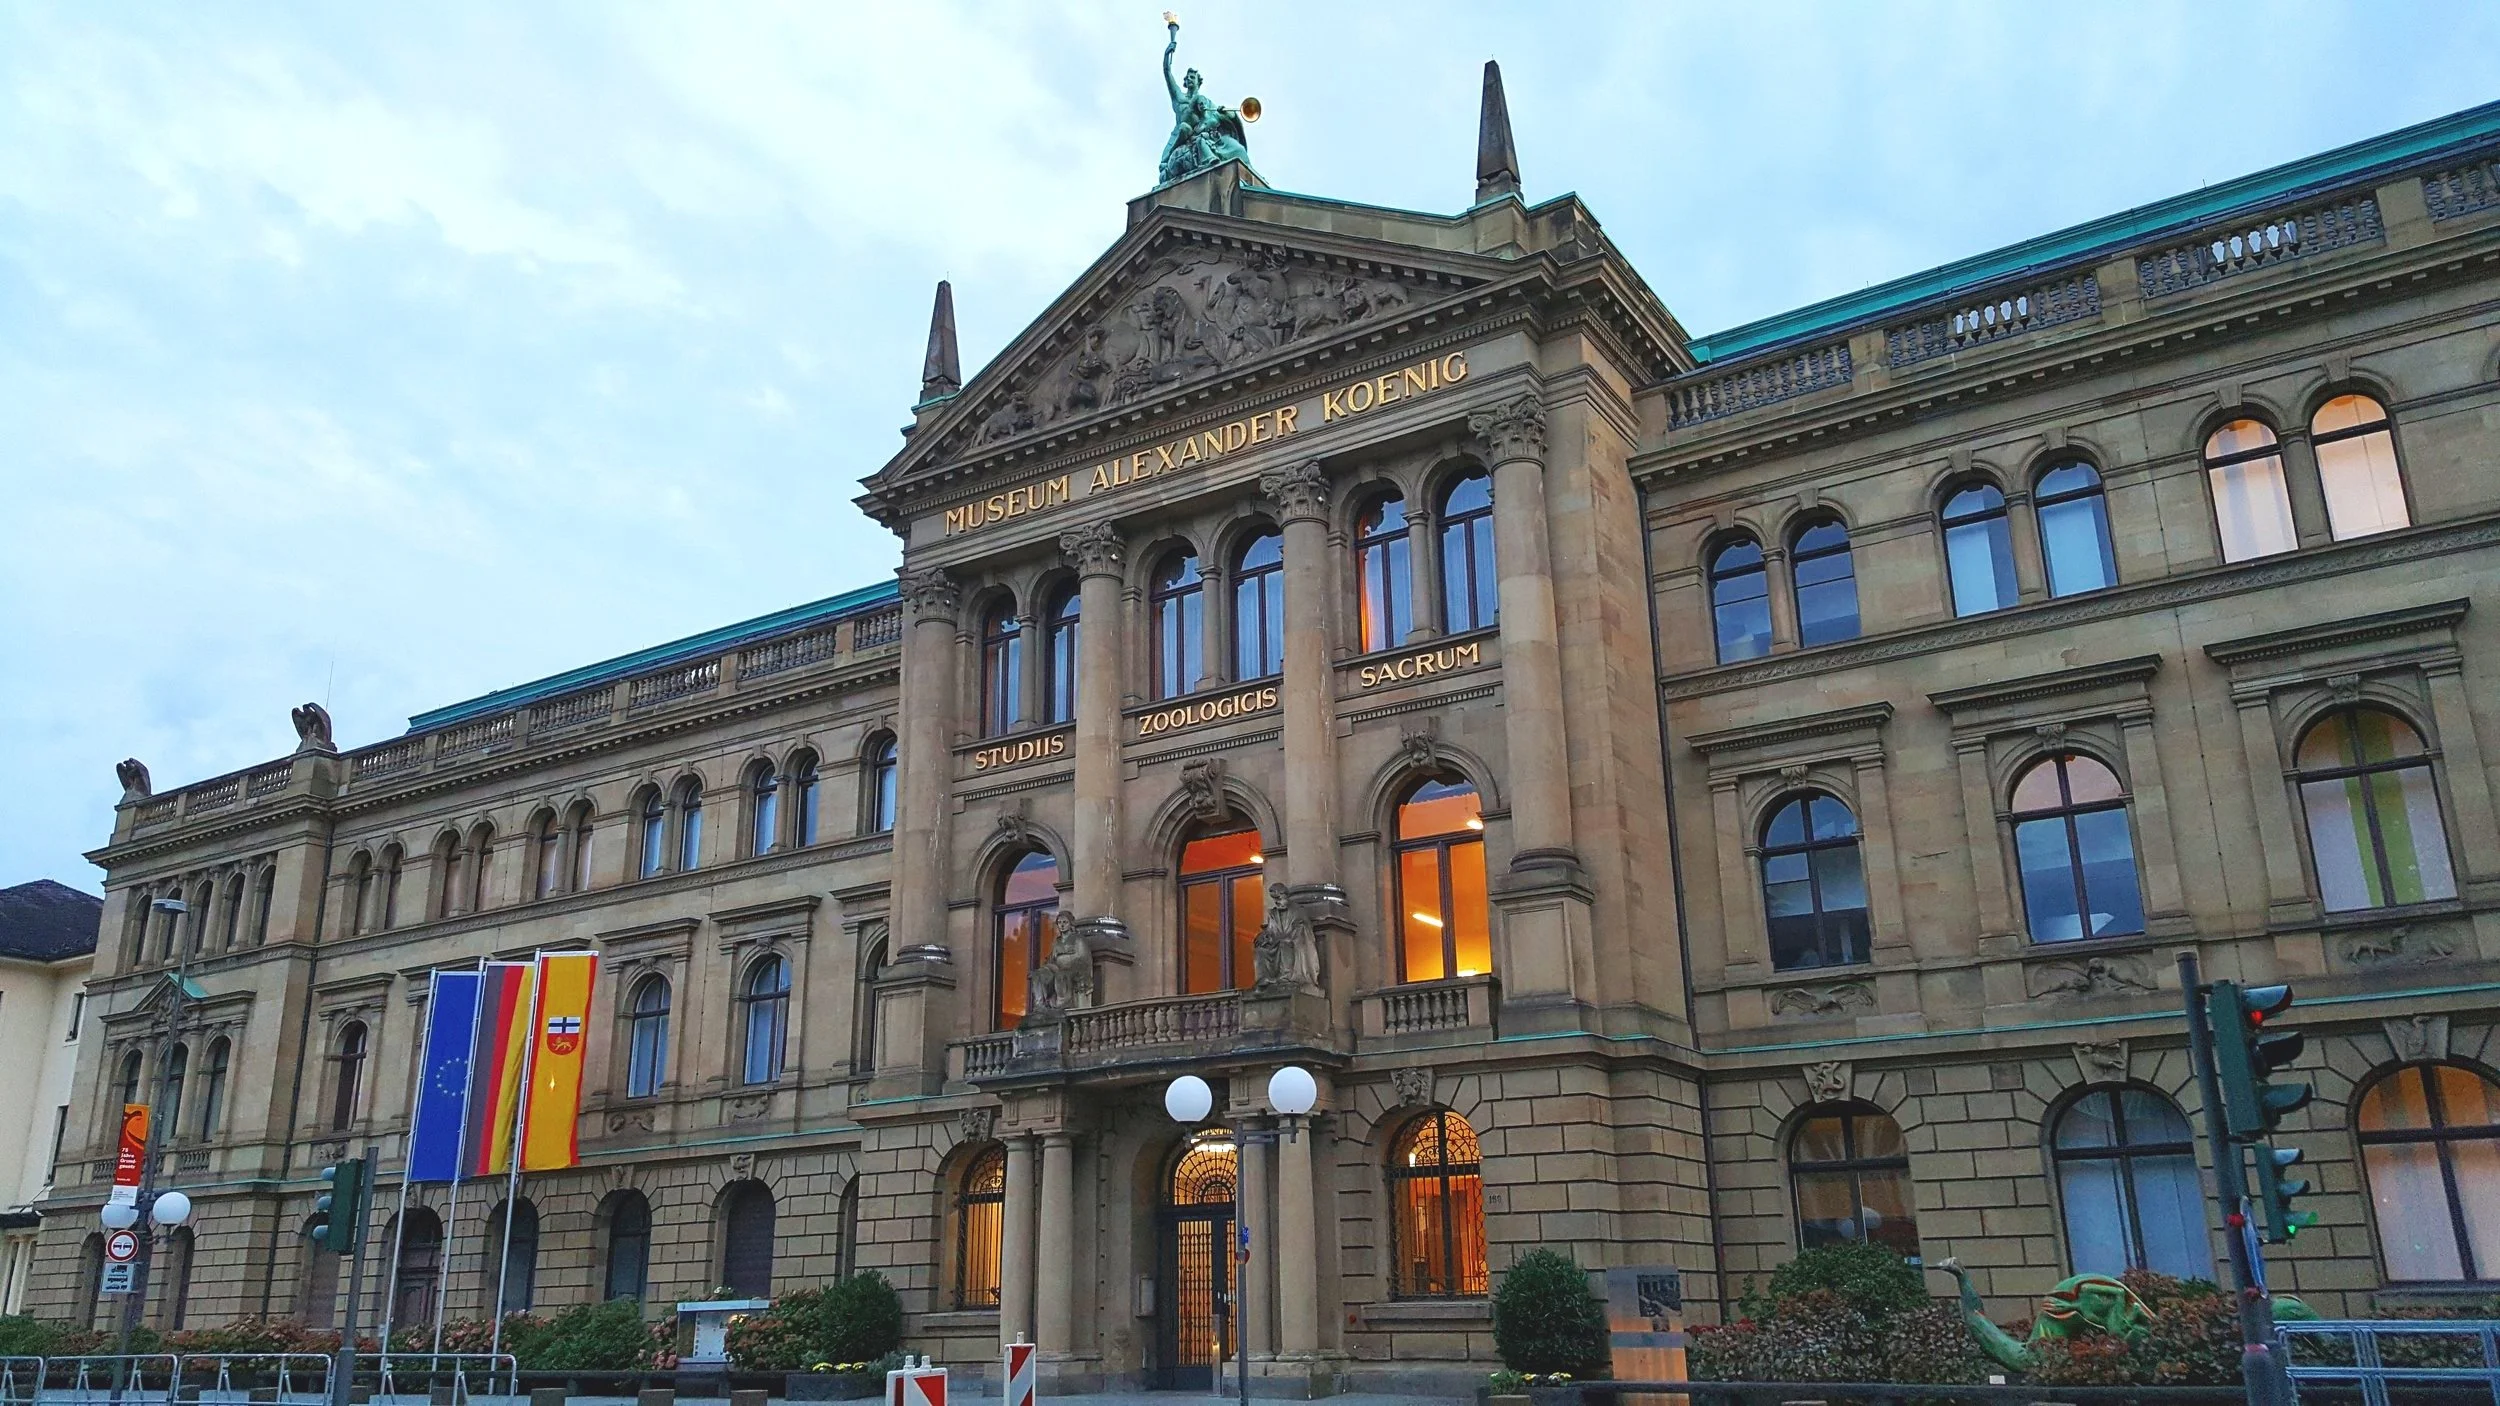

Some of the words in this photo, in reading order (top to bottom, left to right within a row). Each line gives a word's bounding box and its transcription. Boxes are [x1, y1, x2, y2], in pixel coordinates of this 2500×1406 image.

[945, 474, 1070, 536] MUSEUM
[1088, 405, 1298, 495] ALEXANDER
[1323, 351, 1468, 422] KOENIG
[975, 734, 1065, 770] STUDIIS
[1139, 687, 1278, 736] ZOOLOGICIS
[1360, 642, 1480, 688] SACRUM
